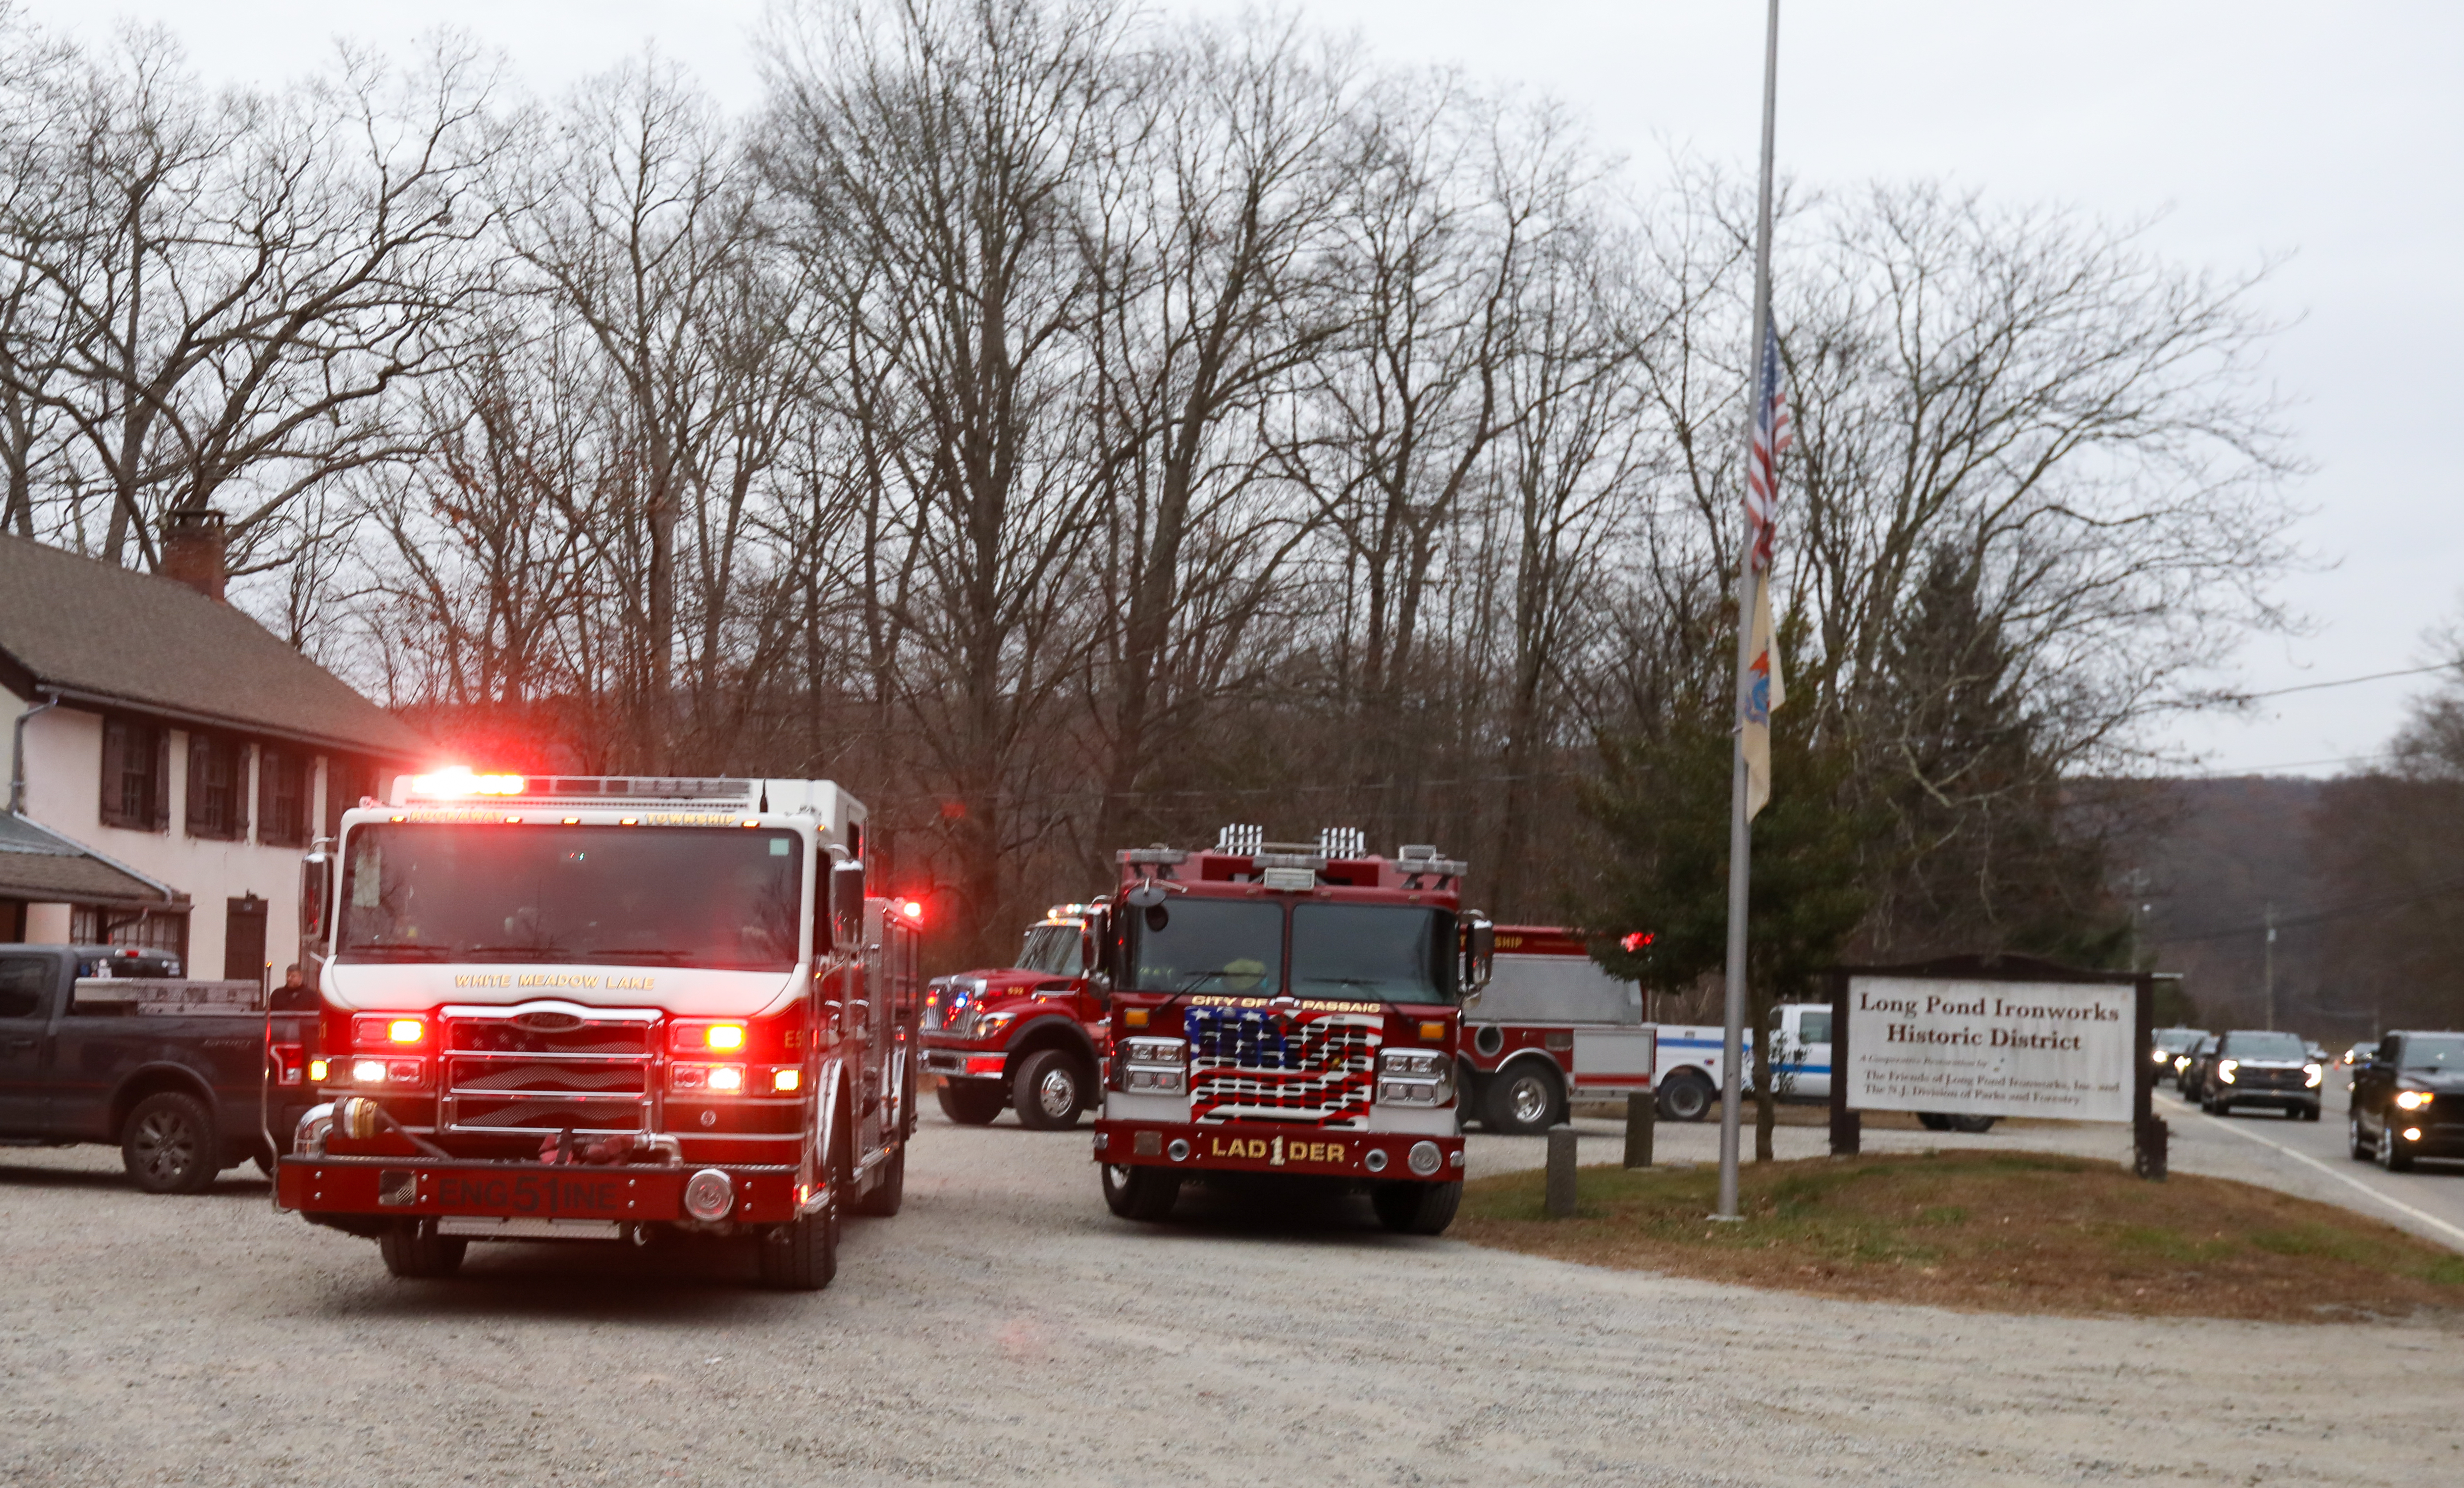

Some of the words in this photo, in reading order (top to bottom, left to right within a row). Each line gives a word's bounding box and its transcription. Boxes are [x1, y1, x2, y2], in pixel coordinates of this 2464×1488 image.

[407, 810, 504, 824] ROCKAWAY
[645, 813, 736, 826] TOWNSHIP
[455, 974, 511, 988] WHITE
[518, 974, 599, 989] MEADOW
[606, 976, 655, 991] LAKE
[1191, 995, 1238, 1007] CITY
[1241, 997, 1268, 1008] OF
[1302, 999, 1381, 1013] PASSAIC
[1859, 992, 1918, 1018] Long
[1926, 995, 1986, 1016] Pond
[1994, 997, 2119, 1021] Ironworks
[1887, 1023, 1983, 1045] Historic
[1990, 1027, 2081, 1051] District
[1865, 1069, 1885, 1080] The
[1889, 1070, 1930, 1082] Friends
[1932, 1071, 1944, 1083] of
[1945, 1073, 1973, 1087] Long
[1977, 1074, 2006, 1086] Pond
[1865, 1084, 1884, 1094] The
[1960, 1089, 1972, 1099] of
[1975, 1089, 2006, 1100] Parks
[2009, 1092, 2030, 1102] and
